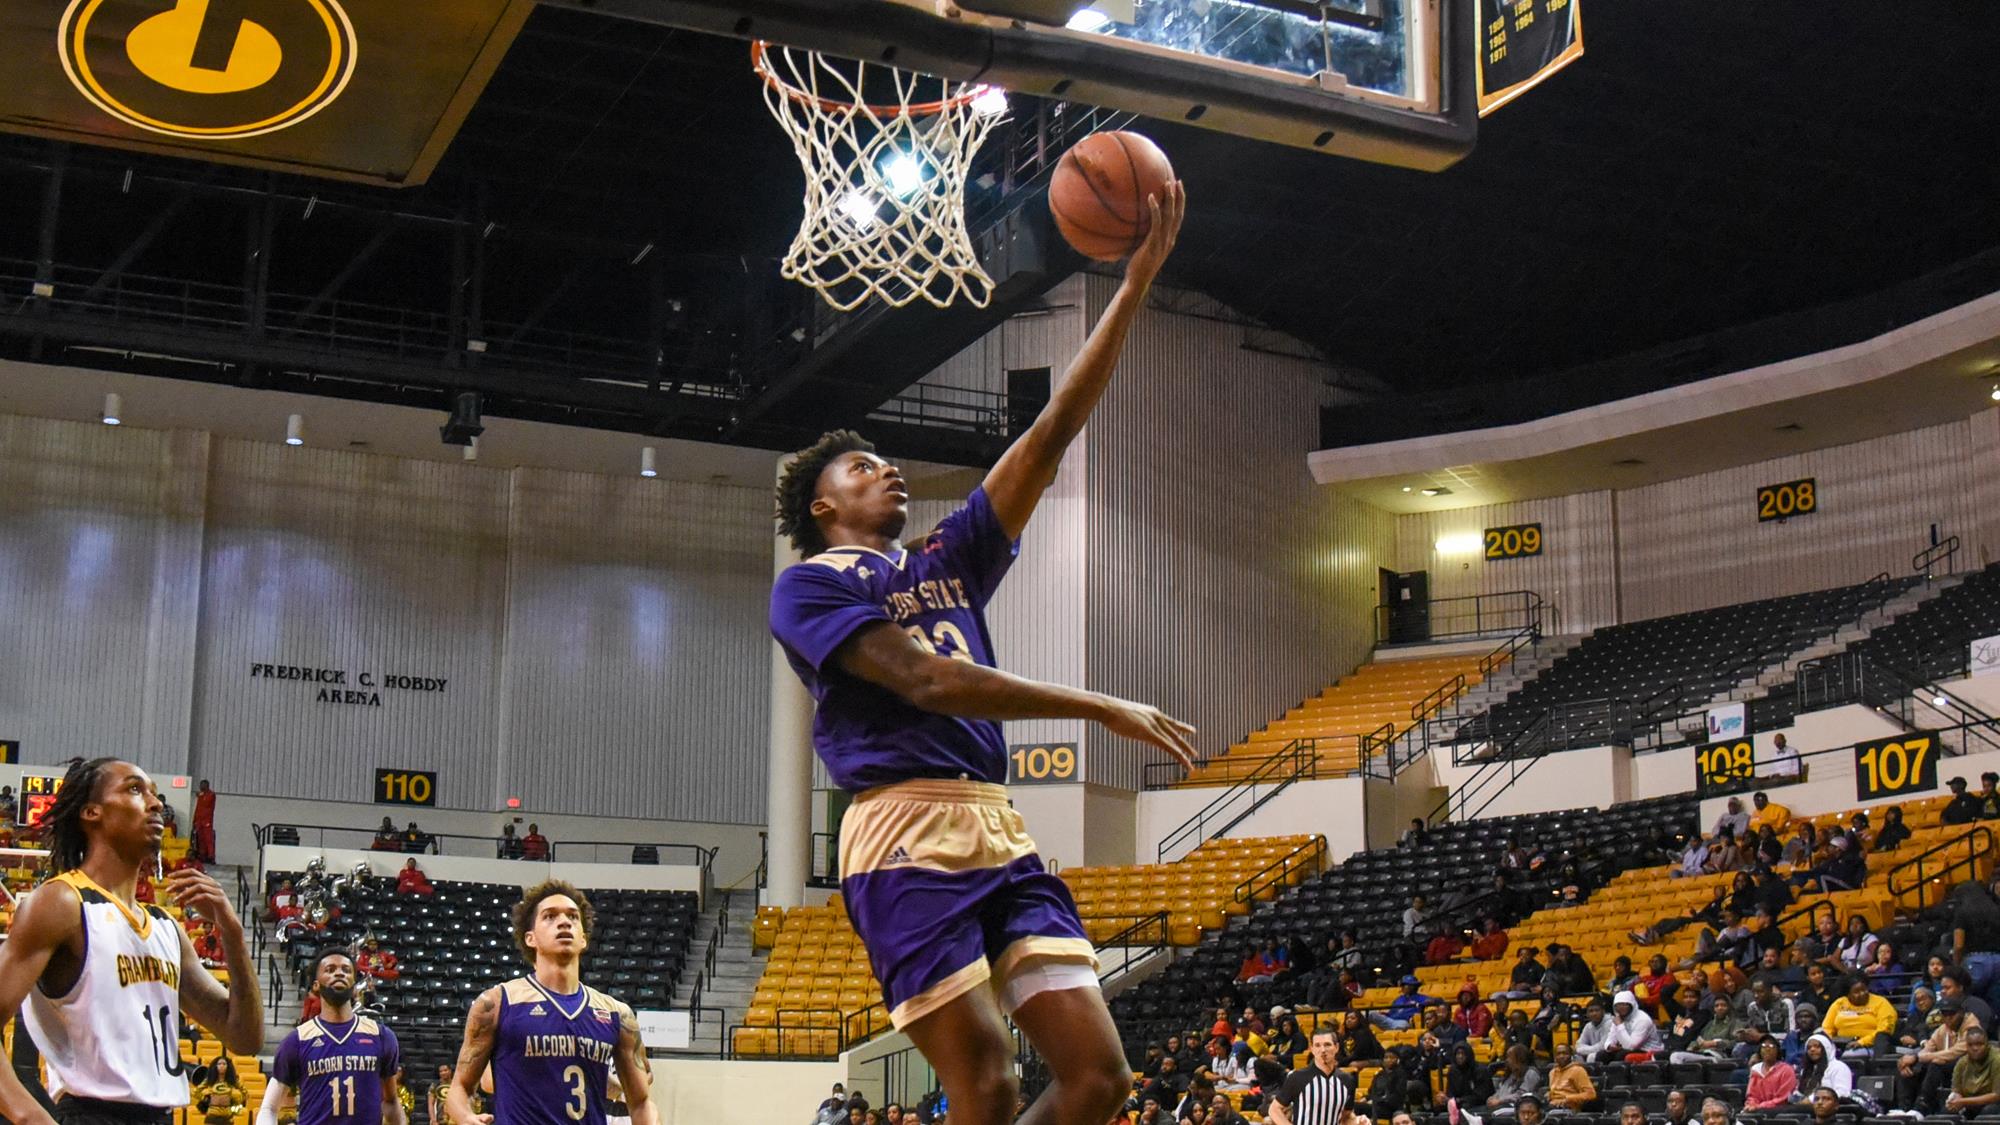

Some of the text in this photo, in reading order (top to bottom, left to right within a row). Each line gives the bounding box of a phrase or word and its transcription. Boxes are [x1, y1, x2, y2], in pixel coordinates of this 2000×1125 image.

[1490, 45, 1507, 64] 1971
[1759, 482, 1815, 517] 208
[1486, 527, 1541, 557] 209
[251, 663, 447, 692] FREDRICK C. HOBDY
[316, 688, 381, 706] ARENA
[1011, 747, 1075, 779] 109
[1697, 743, 1752, 785] 108
[1860, 738, 1929, 793] 107
[381, 766, 431, 803] 110
[143, 1004, 184, 1077] 10
[525, 1035, 614, 1065] ALCORN STATE
[308, 1055, 377, 1076] ALCORN STATE
[328, 1076, 356, 1117] 11
[563, 1065, 587, 1121] 3
